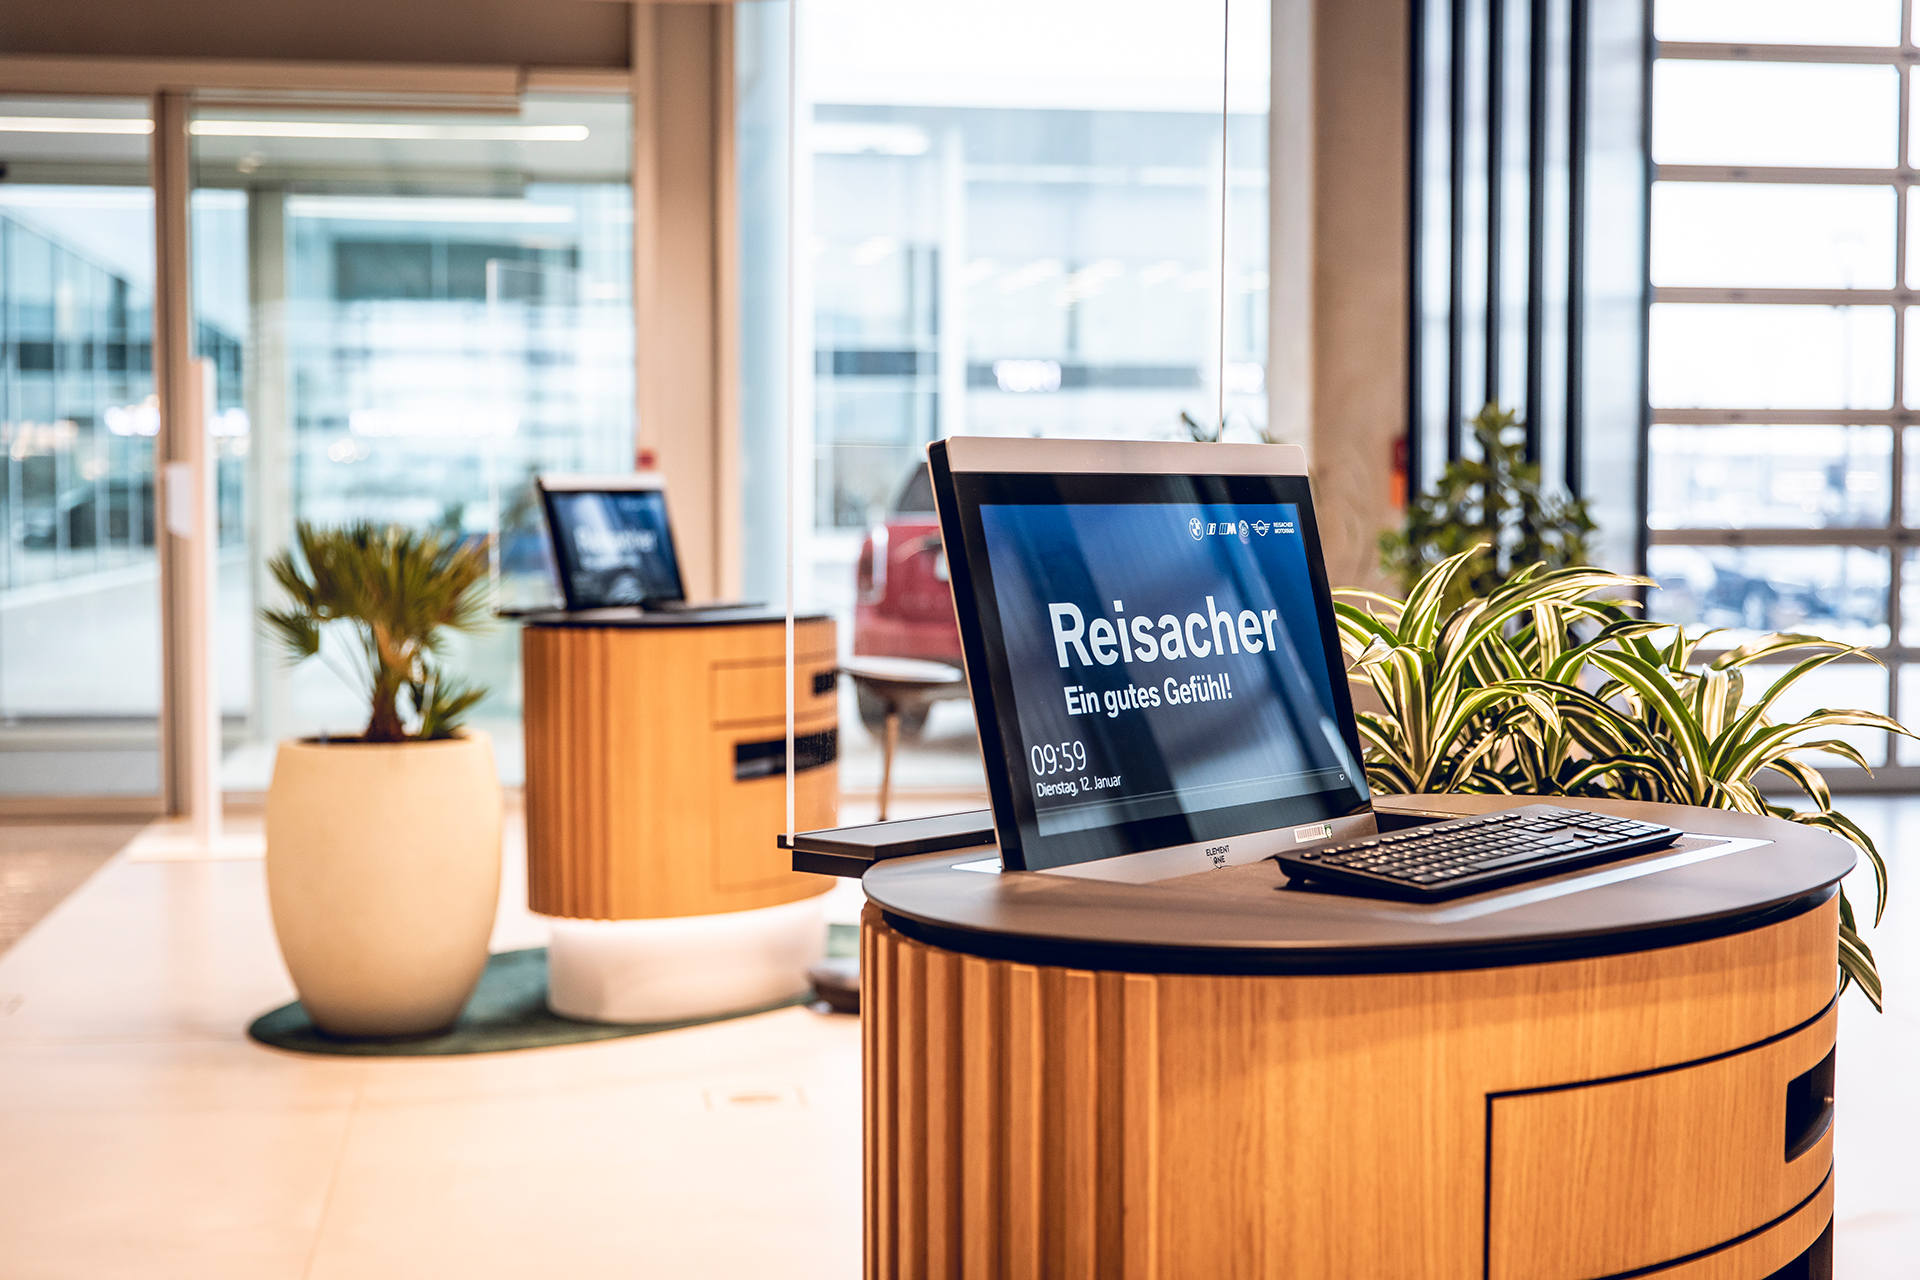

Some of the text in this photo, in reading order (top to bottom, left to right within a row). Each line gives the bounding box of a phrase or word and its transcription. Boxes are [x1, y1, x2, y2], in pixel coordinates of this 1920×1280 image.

[1048, 596, 1278, 668] Reisacher
[1063, 673, 1232, 718] Ein gutes Gefühl!
[1030, 740, 1087, 776] 09:59
[1036, 774, 1121, 797] Dienstag, 12. Januar
[1206, 845, 1230, 856] ELEMENT
[1213, 855, 1225, 864] ONE
